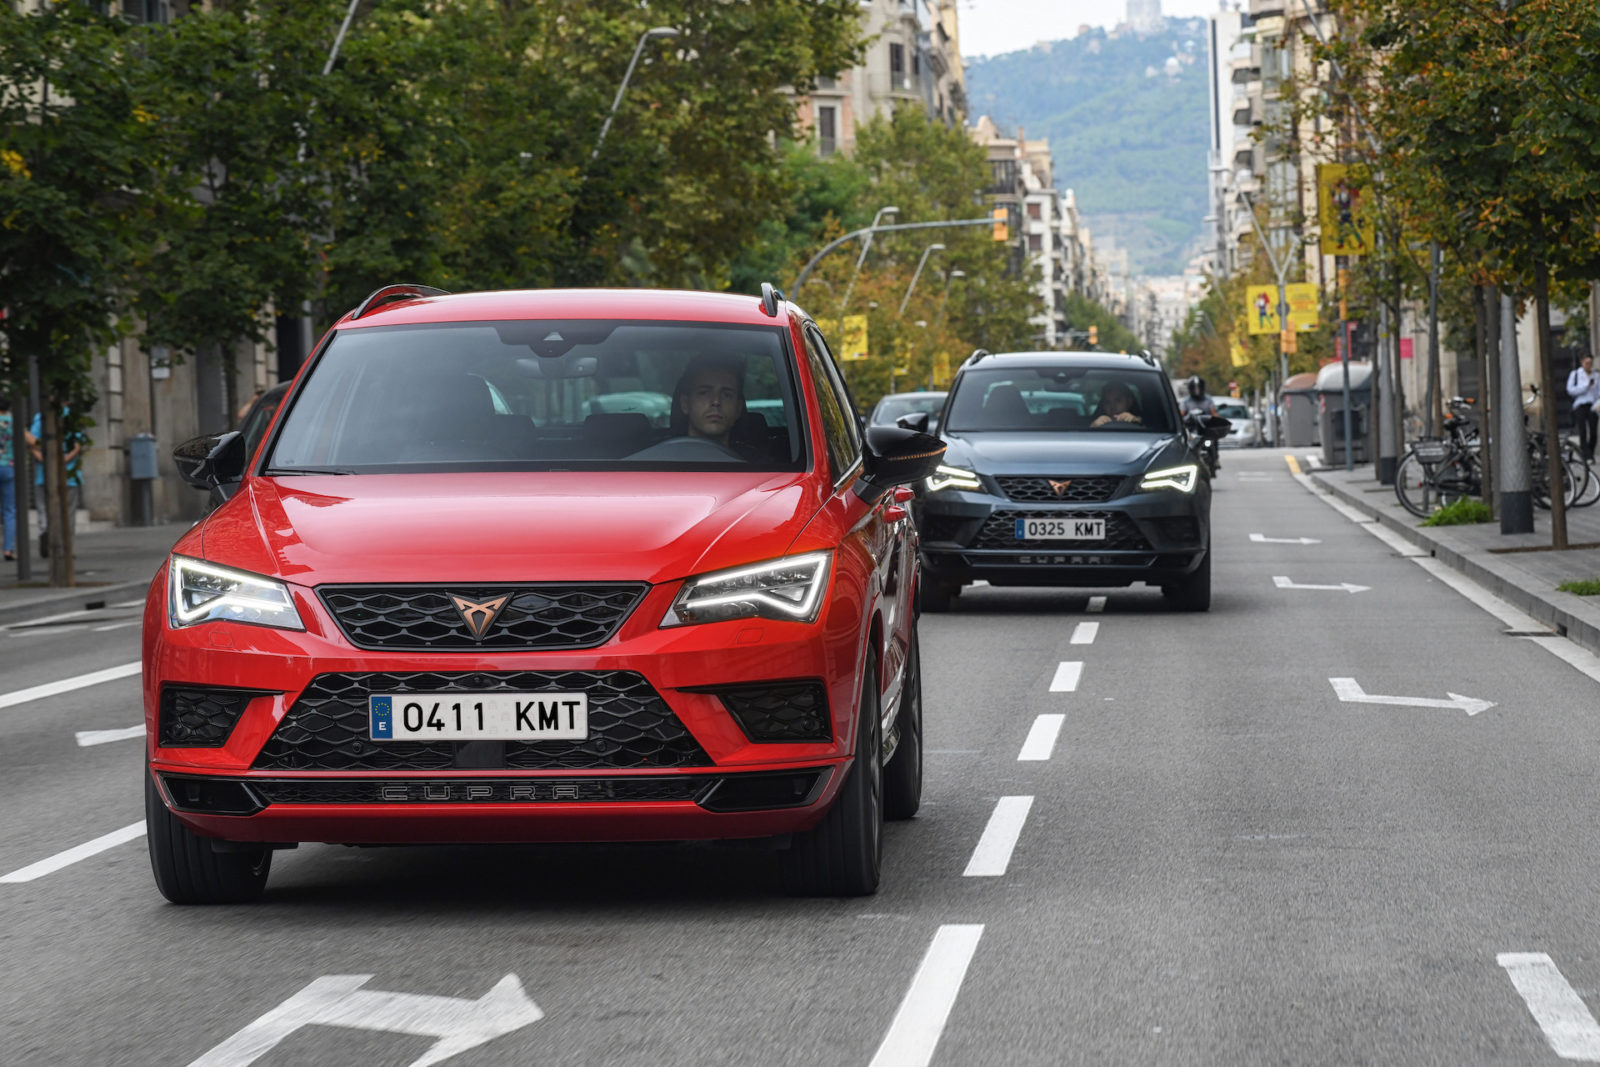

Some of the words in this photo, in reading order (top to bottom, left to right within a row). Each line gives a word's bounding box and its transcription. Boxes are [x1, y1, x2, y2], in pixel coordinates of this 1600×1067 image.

[1028, 522, 1065, 536] 0325
[1074, 522, 1103, 536] KMT
[403, 702, 485, 732] 0411
[515, 701, 581, 731] KMT
[378, 721, 387, 731] E
[381, 785, 579, 801] CUPRA
